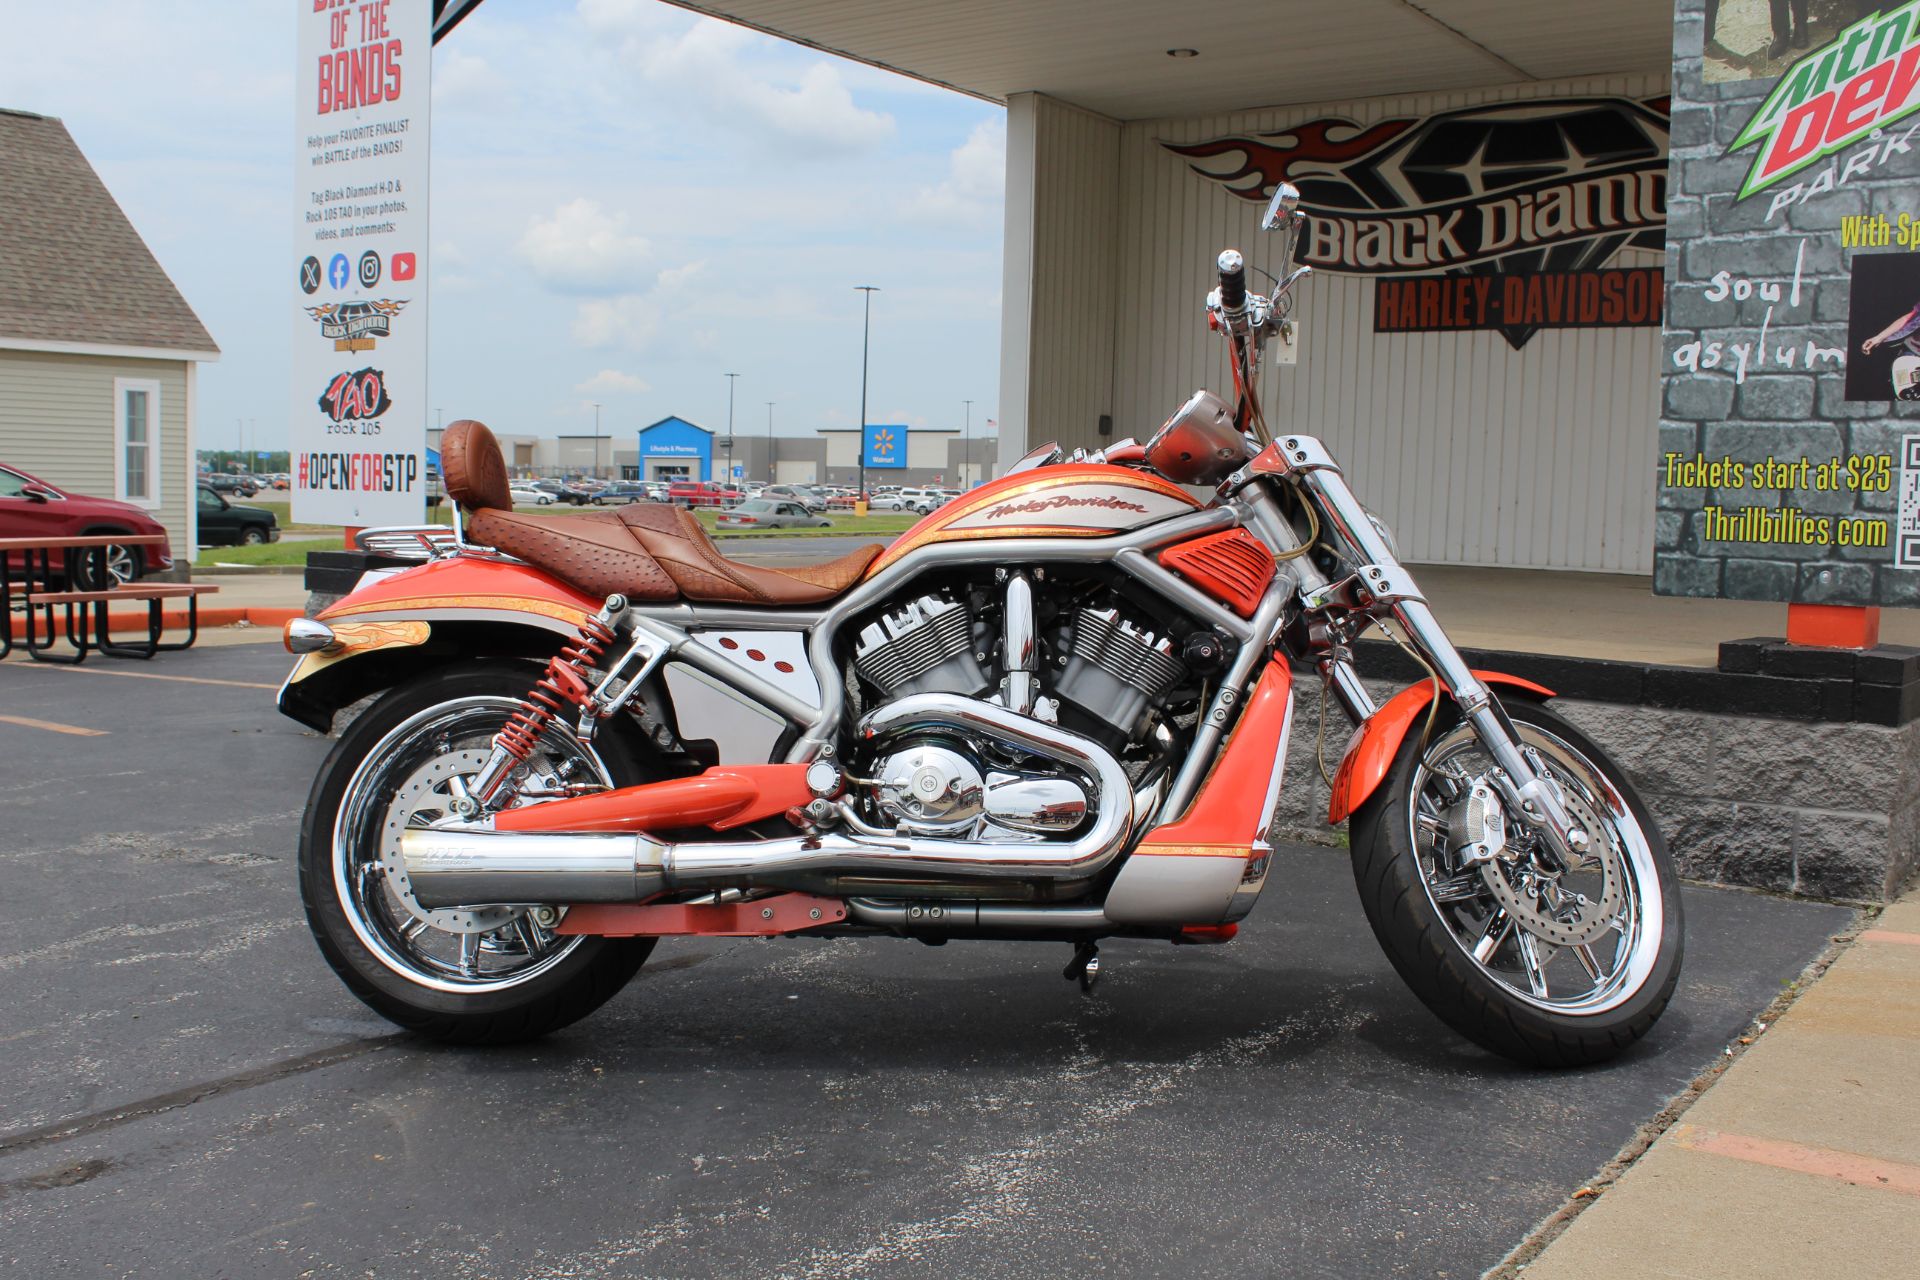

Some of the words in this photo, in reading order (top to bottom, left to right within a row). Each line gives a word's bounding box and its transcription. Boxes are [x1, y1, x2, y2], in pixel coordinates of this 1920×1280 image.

[330, 9, 351, 49] OF
[359, 0, 390, 42] THE
[318, 39, 402, 115] BANDS
[1765, 10, 1912, 122] Mtn
[307, 135, 323, 149] Help
[324, 134, 339, 148] your
[340, 124, 375, 143] FAVORITE
[375, 119, 409, 137] FINALIST
[312, 153, 323, 166] win
[324, 148, 350, 164] BATTLE
[351, 146, 359, 160] of
[360, 145, 371, 158] the
[373, 139, 403, 156] BANDS!
[311, 191, 324, 206] Tag
[325, 188, 344, 202] Black
[346, 182, 378, 199] Diamond
[379, 180, 394, 194] H-D
[395, 179, 402, 193] &
[1764, 122, 1920, 223] PARK
[305, 210, 322, 223] Rock
[324, 207, 338, 221] 105
[339, 205, 353, 219] TAO
[354, 204, 361, 217] in
[362, 204, 378, 219] your
[379, 200, 407, 217] photos,
[340, 224, 354, 238] and
[355, 220, 396, 236] comments:
[1477, 169, 1667, 252] Diamo
[1841, 213, 1890, 248] With
[1896, 211, 1920, 251] Sp
[1672, 306, 1846, 384] asylum
[327, 422, 357, 435] rock
[361, 421, 382, 436] 105
[298, 452, 417, 492] #OPENFORSTP
[872, 456, 895, 464] Walmart
[1665, 451, 1745, 489] Tickets
[1752, 455, 1809, 490] start
[1815, 456, 1841, 491] at
[1847, 454, 1892, 493] $25
[1703, 506, 1888, 547] Thrillbillies.com
